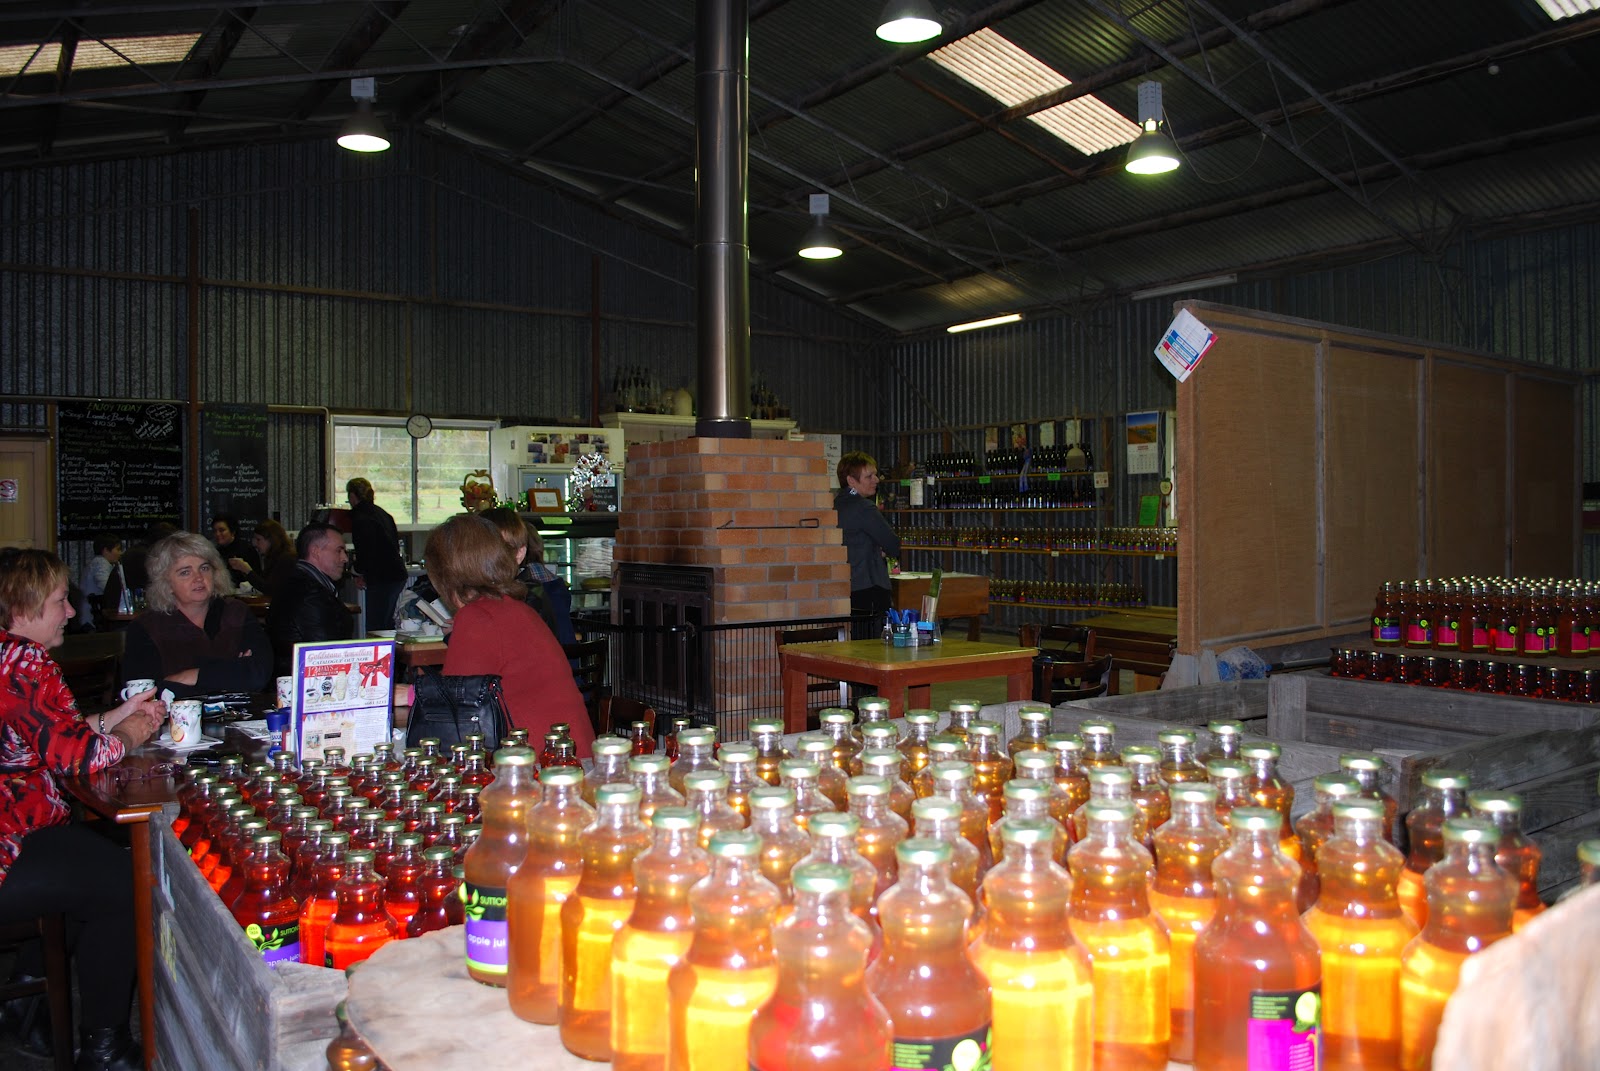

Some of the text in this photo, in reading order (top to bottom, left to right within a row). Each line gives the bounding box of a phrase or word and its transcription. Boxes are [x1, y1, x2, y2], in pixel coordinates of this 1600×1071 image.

[87, 403, 114, 412] ENJOY
[117, 404, 142, 413] TODAY
[468, 933, 490, 946] apple
